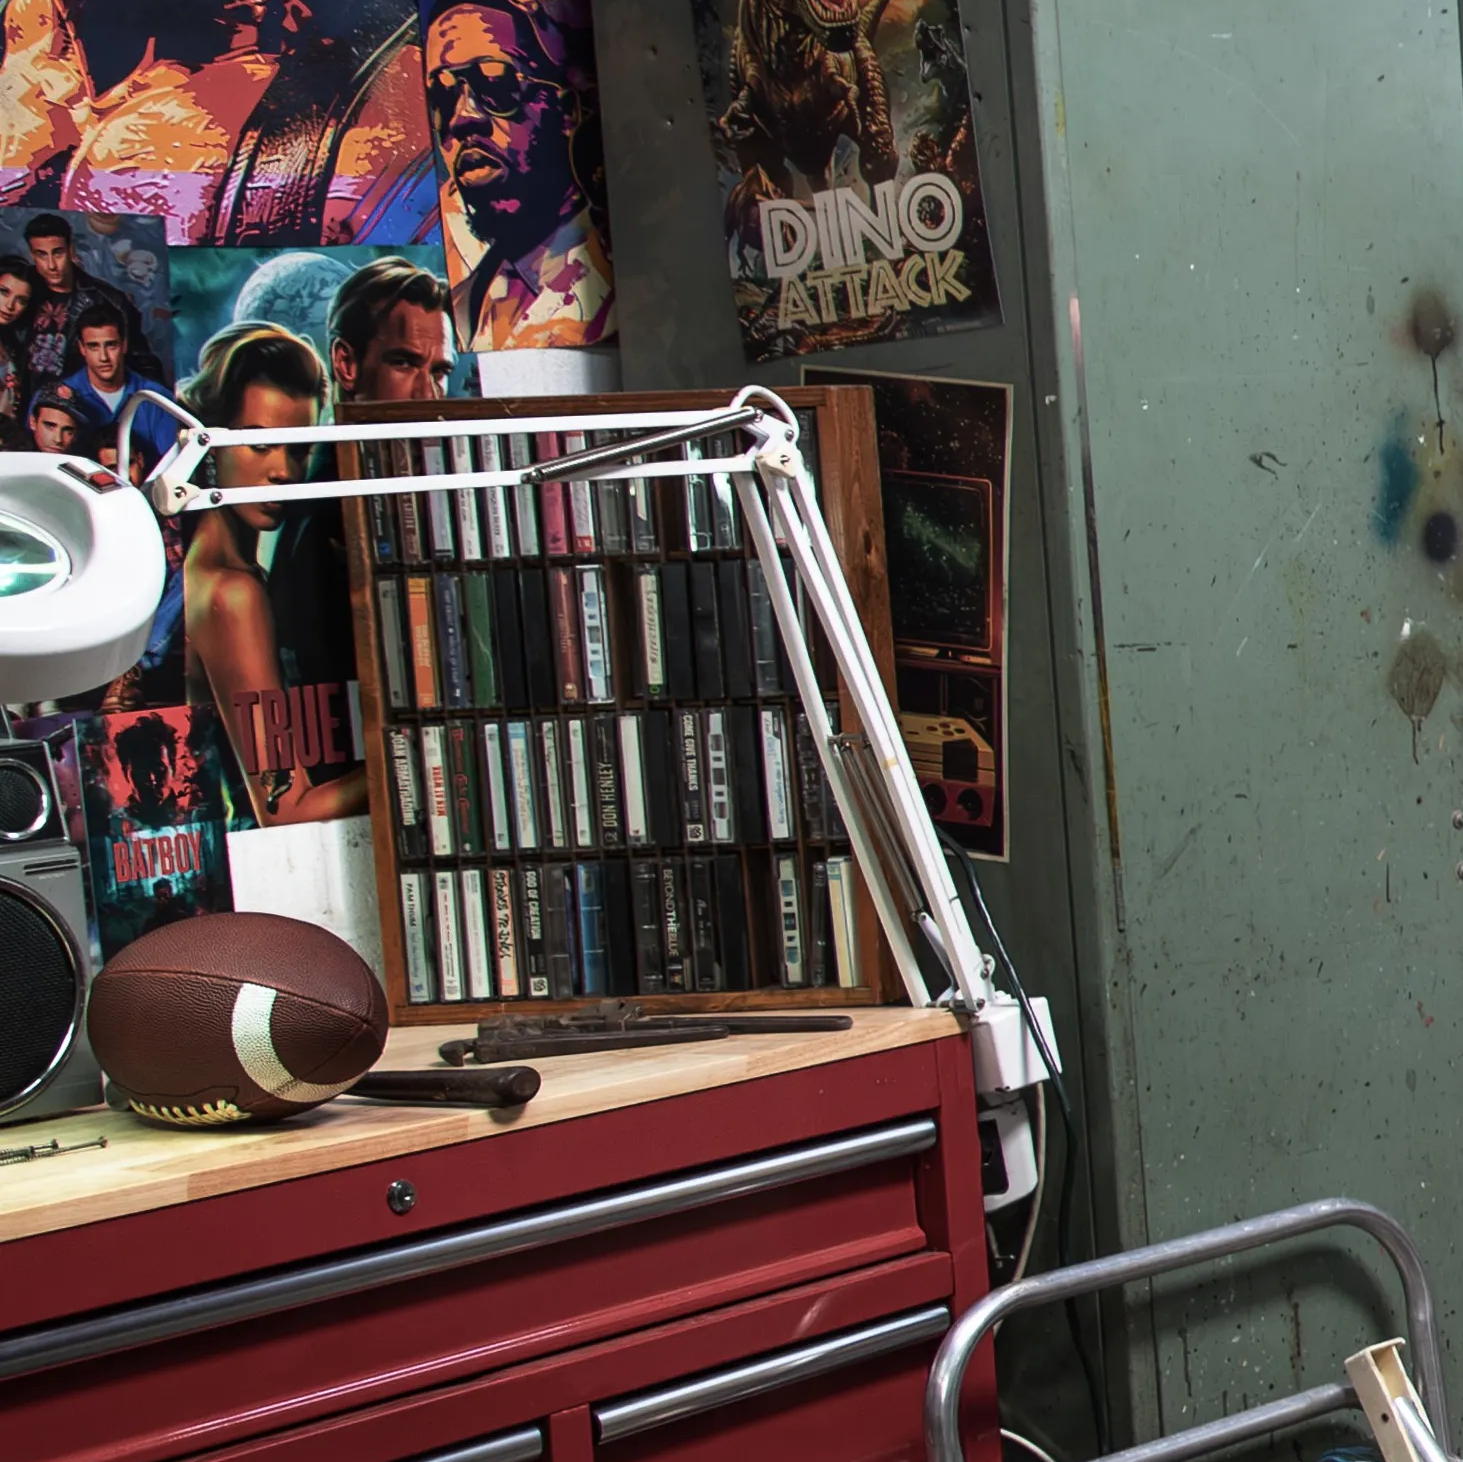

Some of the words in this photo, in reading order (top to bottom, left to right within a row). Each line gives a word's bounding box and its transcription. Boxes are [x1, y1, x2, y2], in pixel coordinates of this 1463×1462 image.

[758, 172, 963, 279] DINO
[777, 249, 971, 330] ATTACK
[232, 682, 346, 774] TRUE
[682, 714, 695, 737] COME
[389, 731, 407, 757] JOAN
[684, 738, 696, 756] GIVE
[598, 761, 616, 802] HENLEY
[686, 759, 699, 791] THANKS
[602, 805, 618, 827] DON
[113, 830, 202, 883] BATBOY
